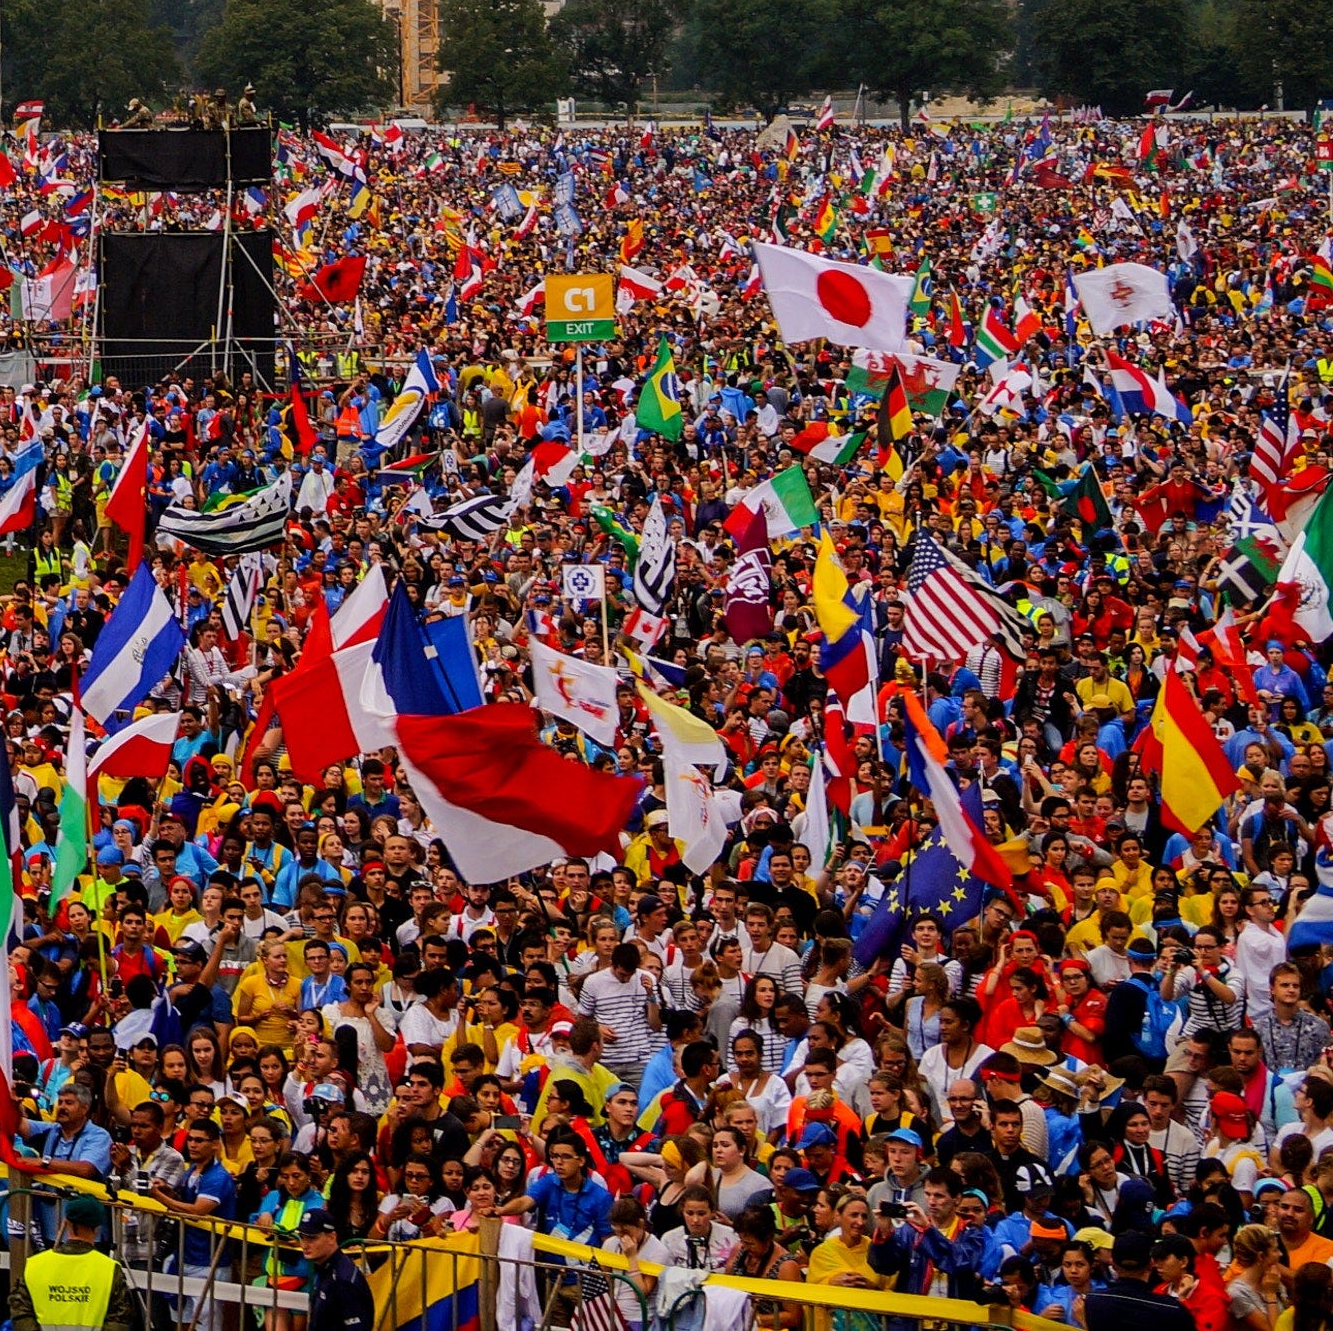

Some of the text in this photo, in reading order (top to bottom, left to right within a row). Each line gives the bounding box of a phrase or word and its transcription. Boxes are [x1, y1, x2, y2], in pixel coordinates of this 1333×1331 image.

[563, 287, 595, 311] C1
[566, 322, 594, 335] EXIT
[48, 1285, 91, 1294] WOJSKO
[48, 1293, 90, 1303] POLSKIE
